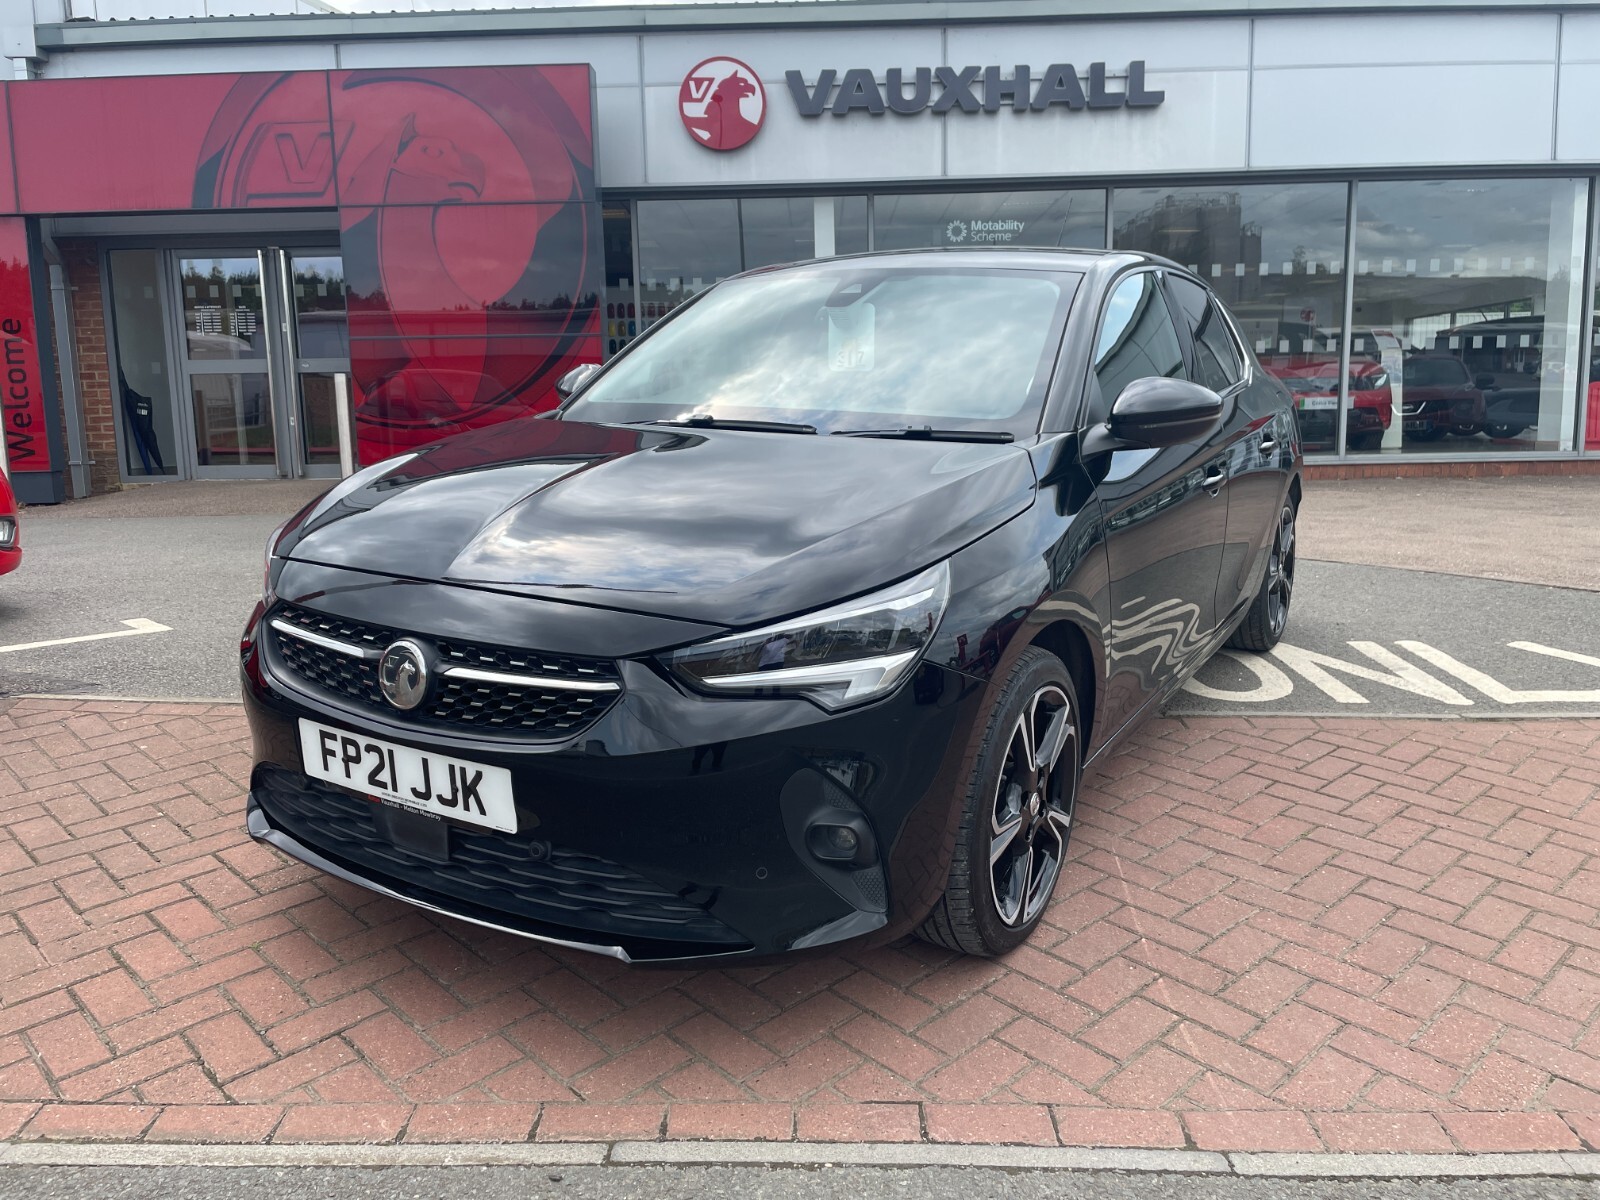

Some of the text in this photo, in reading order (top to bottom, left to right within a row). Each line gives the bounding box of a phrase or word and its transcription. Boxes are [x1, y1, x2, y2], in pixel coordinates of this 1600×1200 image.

[785, 60, 1165, 117] VAUXHALL
[971, 220, 1024, 232] Motability
[971, 231, 1011, 242] Scheme
[2, 318, 35, 462] Welcome
[318, 729, 487, 817] FP21 JJK
